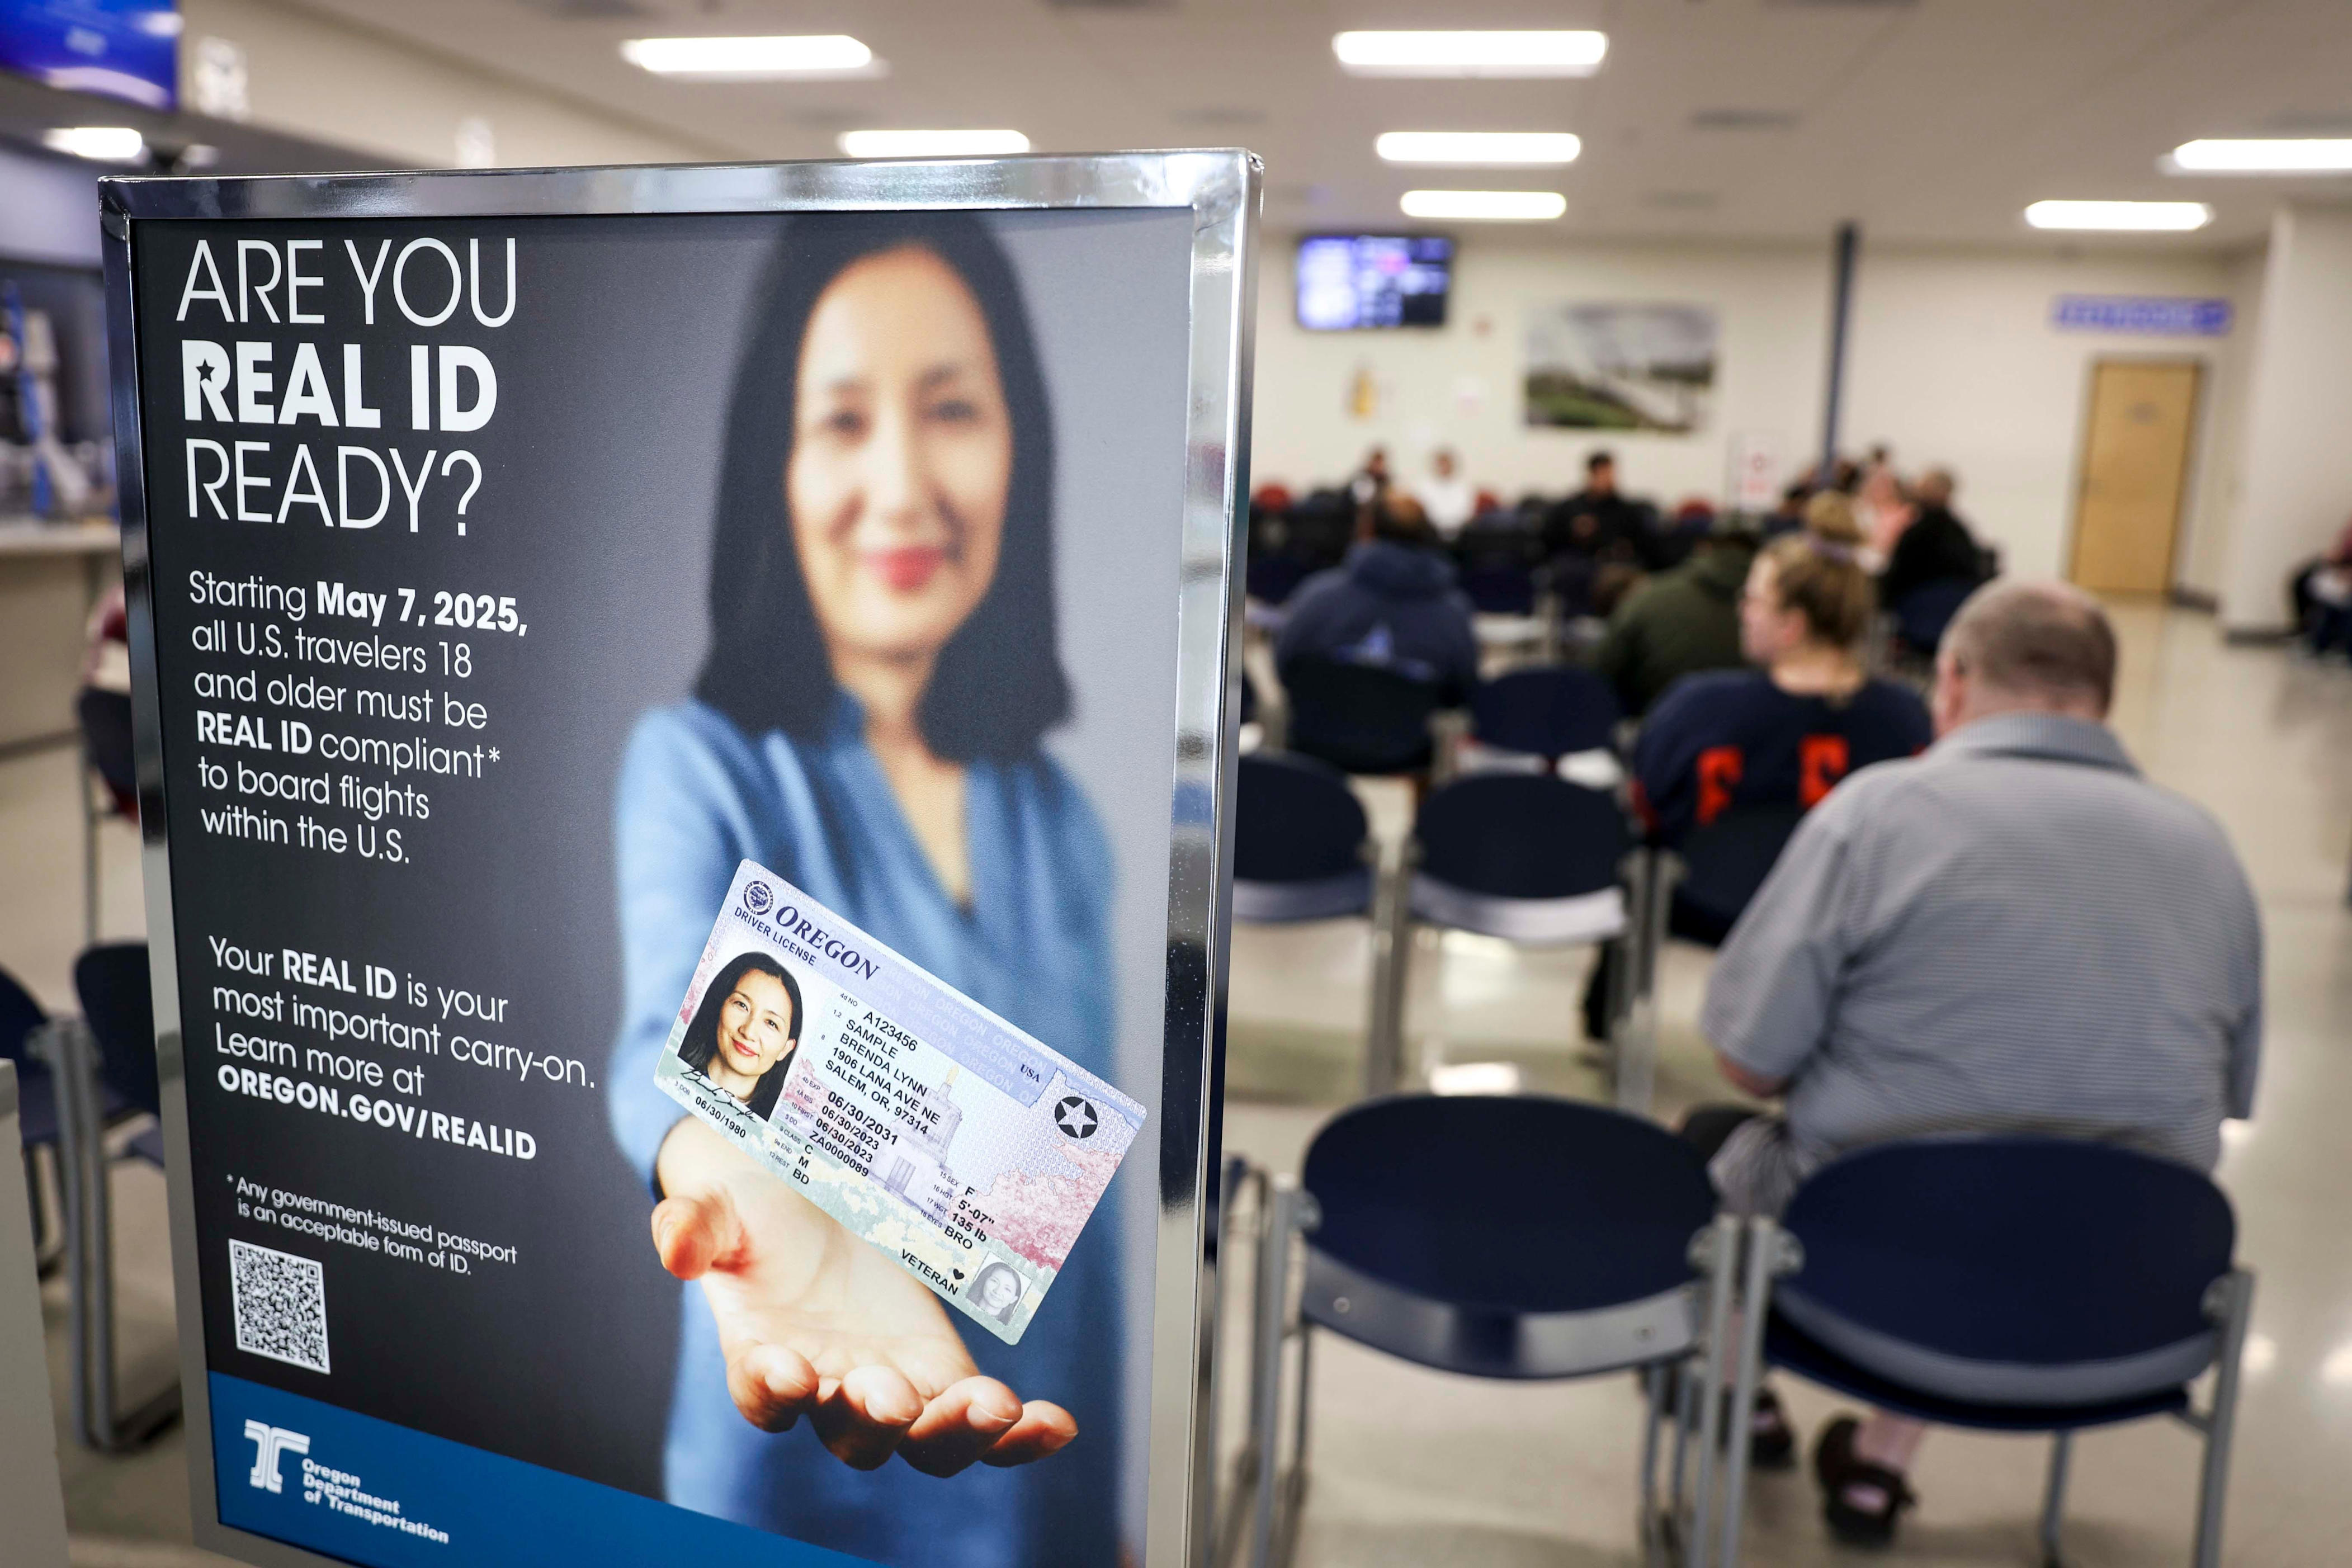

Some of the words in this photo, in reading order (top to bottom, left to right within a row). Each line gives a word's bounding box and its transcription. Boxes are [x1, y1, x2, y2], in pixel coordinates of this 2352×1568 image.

[176, 239, 325, 324] ARE
[344, 237, 516, 327] YOU
[182, 339, 381, 428] REAL
[410, 344, 497, 432] ID
[186, 438, 482, 536] READY?
[190, 570, 305, 621] Starting
[317, 581, 386, 626] May
[398, 588, 426, 626] 7,
[434, 591, 527, 636] 2025,
[191, 620, 225, 652] all
[237, 621, 289, 659] U.S.
[295, 627, 427, 673] travelers
[439, 641, 471, 678] 18
[194, 670, 256, 702] and
[267, 674, 347, 712] older
[357, 688, 432, 723] must
[445, 691, 488, 729] be
[196, 710, 272, 751] REAL
[281, 720, 312, 754] ID
[198, 756, 228, 790] to
[238, 761, 329, 805] board
[339, 774, 429, 820] flights
[201, 805, 287, 844] within
[297, 815, 347, 853] the
[357, 824, 409, 863] U.S.
[734, 907, 771, 937] DRIVER
[773, 932, 816, 966] LICENSE
[776, 905, 881, 980] OREGON
[209, 935, 274, 976] Your
[282, 949, 357, 993] REAL
[365, 965, 397, 1001] ID
[407, 973, 428, 1008] is
[437, 985, 508, 1023] your
[848, 998, 858, 1007] NO
[213, 986, 284, 1022] most
[292, 995, 441, 1055] important
[450, 1036, 595, 1089] carry-on.
[216, 1022, 296, 1068] Learn
[306, 1047, 383, 1088] more
[393, 1065, 424, 1096] at
[847, 1019, 898, 1059] SAMPLE
[863, 1011, 918, 1051] A123456
[679, 1085, 690, 1095] DOB
[833, 1047, 858, 1069] 1906
[859, 1065, 891, 1093] LANA
[894, 1089, 921, 1112] AVE
[922, 1107, 941, 1125] NE
[840, 1033, 890, 1074] BRENDA
[894, 1069, 927, 1097] LYNN
[1020, 1064, 1040, 1083] USA
[218, 1064, 536, 1160] OREGON.GOV/REALID
[696, 1097, 746, 1138] 06/30/1980
[803, 1094, 813, 1104] ISS
[822, 1105, 879, 1150] 06/30/2023
[809, 1080, 821, 1091] EXP
[828, 1092, 898, 1146] 06/30/2031
[826, 1060, 867, 1097] SALEM,
[871, 1091, 891, 1112] OR,
[894, 1107, 928, 1135] 97314
[781, 1144, 792, 1154] END
[799, 1156, 809, 1168] M
[783, 1129, 801, 1144] CLASS
[805, 1144, 813, 1154] C
[797, 1105, 814, 1119] FIRST
[816, 1118, 873, 1163] 06/30/2023
[810, 1131, 869, 1177] ZA0000089
[775, 1156, 790, 1168] REST
[793, 1168, 809, 1185] BD
[939, 1188, 952, 1201] HGT
[946, 1175, 959, 1187] SEX
[965, 1186, 975, 1196] F
[237, 1198, 251, 1218] is
[254, 1206, 277, 1224] an
[281, 1212, 379, 1250] acceptable
[384, 1236, 423, 1262] form
[428, 1249, 446, 1268] of
[450, 1254, 471, 1275] ID.
[272, 1188, 432, 1243] government-issued
[438, 1230, 517, 1264] passport
[927, 1215, 942, 1228] EYES
[944, 1225, 972, 1249] BRO
[934, 1201, 948, 1215] WGT
[952, 1213, 974, 1232] 135
[974, 1229, 986, 1242] lb
[901, 1249, 958, 1295] VETERAN
[302, 1458, 361, 1488] Oregon
[303, 1472, 400, 1515] Department
[304, 1490, 321, 1505] of
[328, 1494, 448, 1544] Transportation
